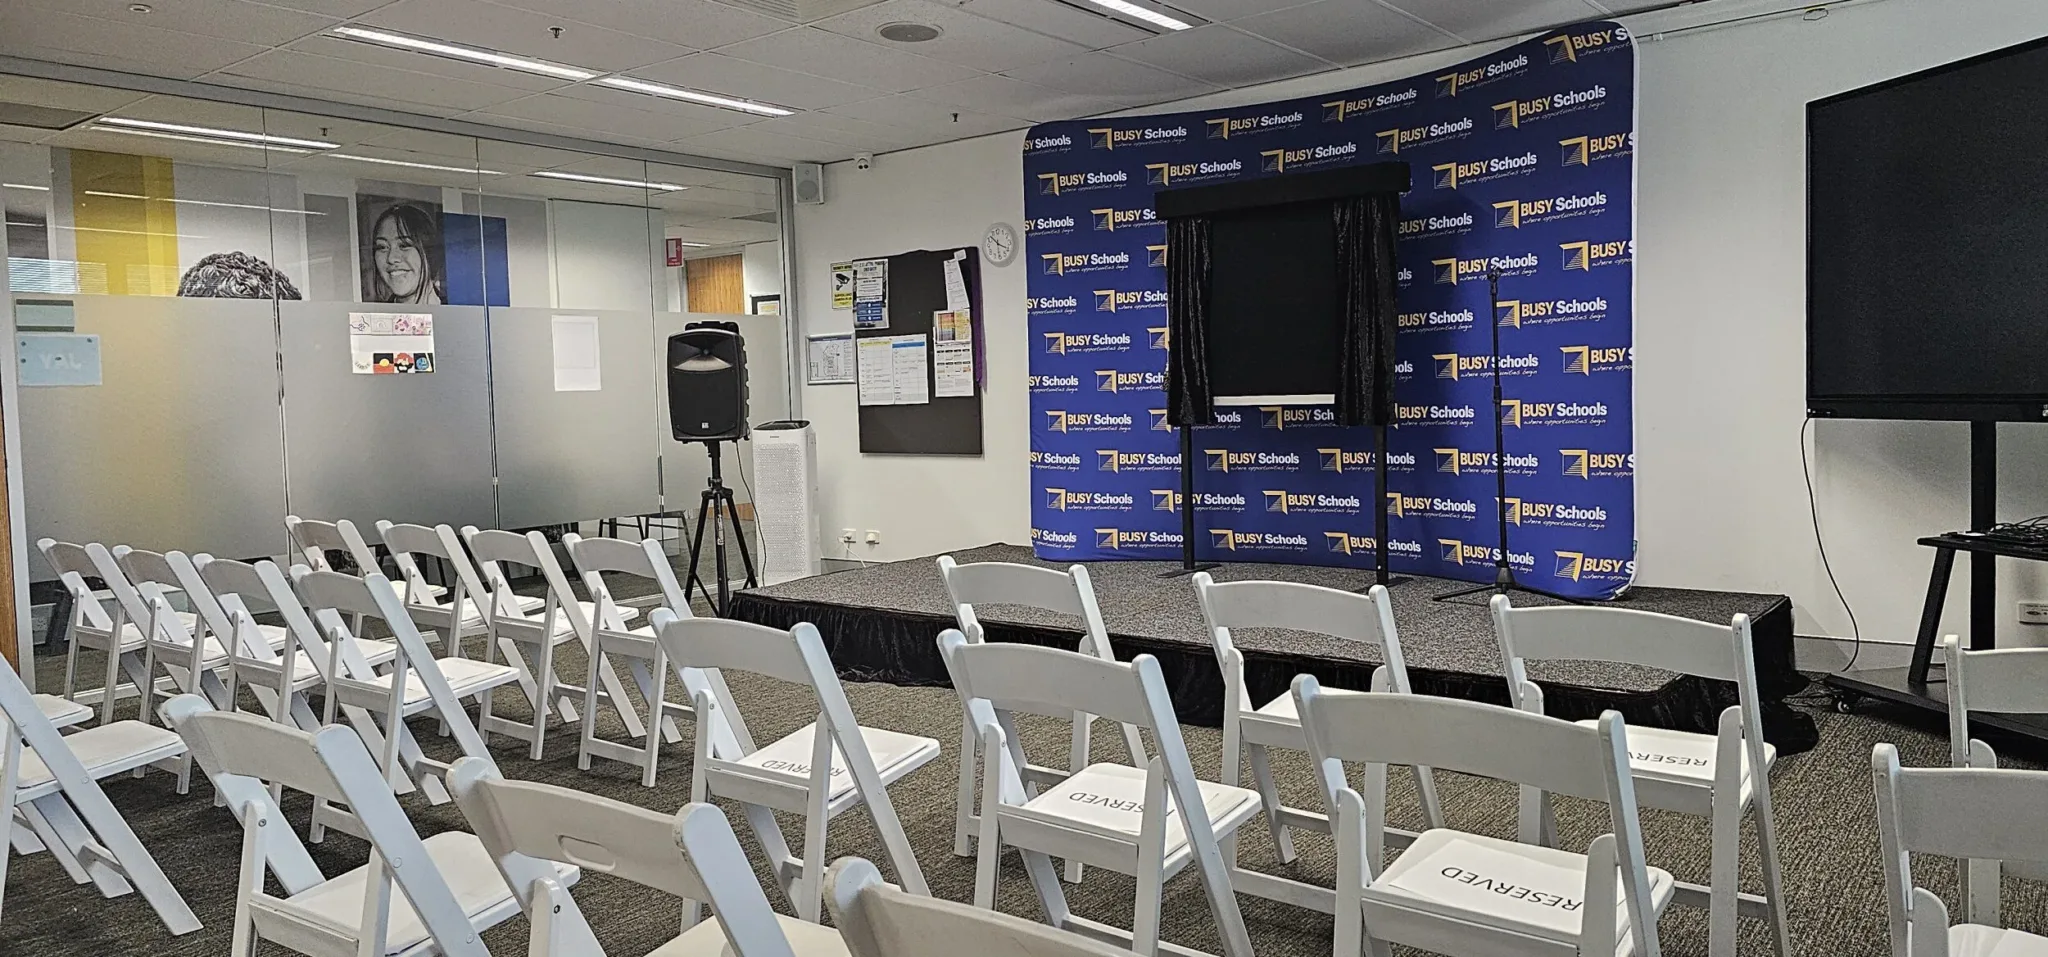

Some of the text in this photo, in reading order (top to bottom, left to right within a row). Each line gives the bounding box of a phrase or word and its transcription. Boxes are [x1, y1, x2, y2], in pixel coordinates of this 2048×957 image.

[1573, 31, 1611, 49] BUSY
[1458, 55, 1528, 85] BUSY Schools
[1346, 88, 1417, 112] BUSY Schools
[1519, 85, 1606, 116] BUSY Schools
[1231, 112, 1302, 130] BUSY Schools
[1114, 126, 1187, 141] BUSY Schools
[1401, 118, 1472, 143] BUSY Schools
[1025, 135, 1071, 150] SY Schools
[1590, 134, 1625, 152] BUSY
[1285, 142, 1356, 163] BUSY Schools
[1170, 159, 1241, 177] BUSY Schools
[1458, 152, 1537, 177] BUSY Schools
[1060, 170, 1127, 186] BUSY Schools
[1521, 191, 1606, 216] BUSY Schools
[1025, 216, 1074, 230] SY Schools
[1114, 210, 1141, 222] BUSY
[1399, 213, 1472, 234] BUSY Schools
[1591, 241, 1626, 259] BUSY
[1064, 252, 1129, 266] BUSY Schools
[1458, 253, 1538, 274] BUSY Schools
[1028, 296, 1077, 308] SY Schools
[1117, 291, 1167, 303] BUSY Scho
[1522, 298, 1607, 317] BUSY Schools
[1399, 309, 1473, 326] BUSY Schools
[1066, 334, 1130, 346] BUSY Schools
[1591, 348, 1627, 363] BUSY
[1460, 356, 1490, 370] BUSY
[1029, 375, 1078, 386] SY Schools
[1118, 374, 1144, 384] BUSY
[1284, 410, 1312, 421] BUSY
[1400, 405, 1474, 419] BUSY Schools
[1523, 402, 1607, 416] BUSY Schools
[1068, 414, 1132, 424] BUSY Schools
[1215, 412, 1241, 422] hools
[1031, 453, 1080, 464] SY Schools
[1120, 454, 1181, 464] BUSY School
[1229, 453, 1299, 464] BUSY Schools
[1343, 453, 1371, 464] BUSY
[1460, 453, 1490, 465] BUSY
[1590, 455, 1625, 468] BUSY
[1067, 492, 1132, 504] BUSY Schools
[1175, 493, 1245, 504] BY Schools
[1288, 495, 1359, 507] BUSY Schools
[1403, 497, 1476, 512] BUSY Schools
[1523, 503, 1606, 520] BUSY Schools
[1031, 529, 1076, 542] SY Schools
[1119, 532, 1183, 542] BUSY Schoo
[1235, 534, 1307, 545] BUSY Schools
[1351, 537, 1421, 553] BUSY chools
[1463, 545, 1534, 565] BUSY Shools
[1583, 559, 1624, 572] BUSY
[1628, 751, 1708, 767] RESER
[1441, 867, 1583, 911] RESERVED
